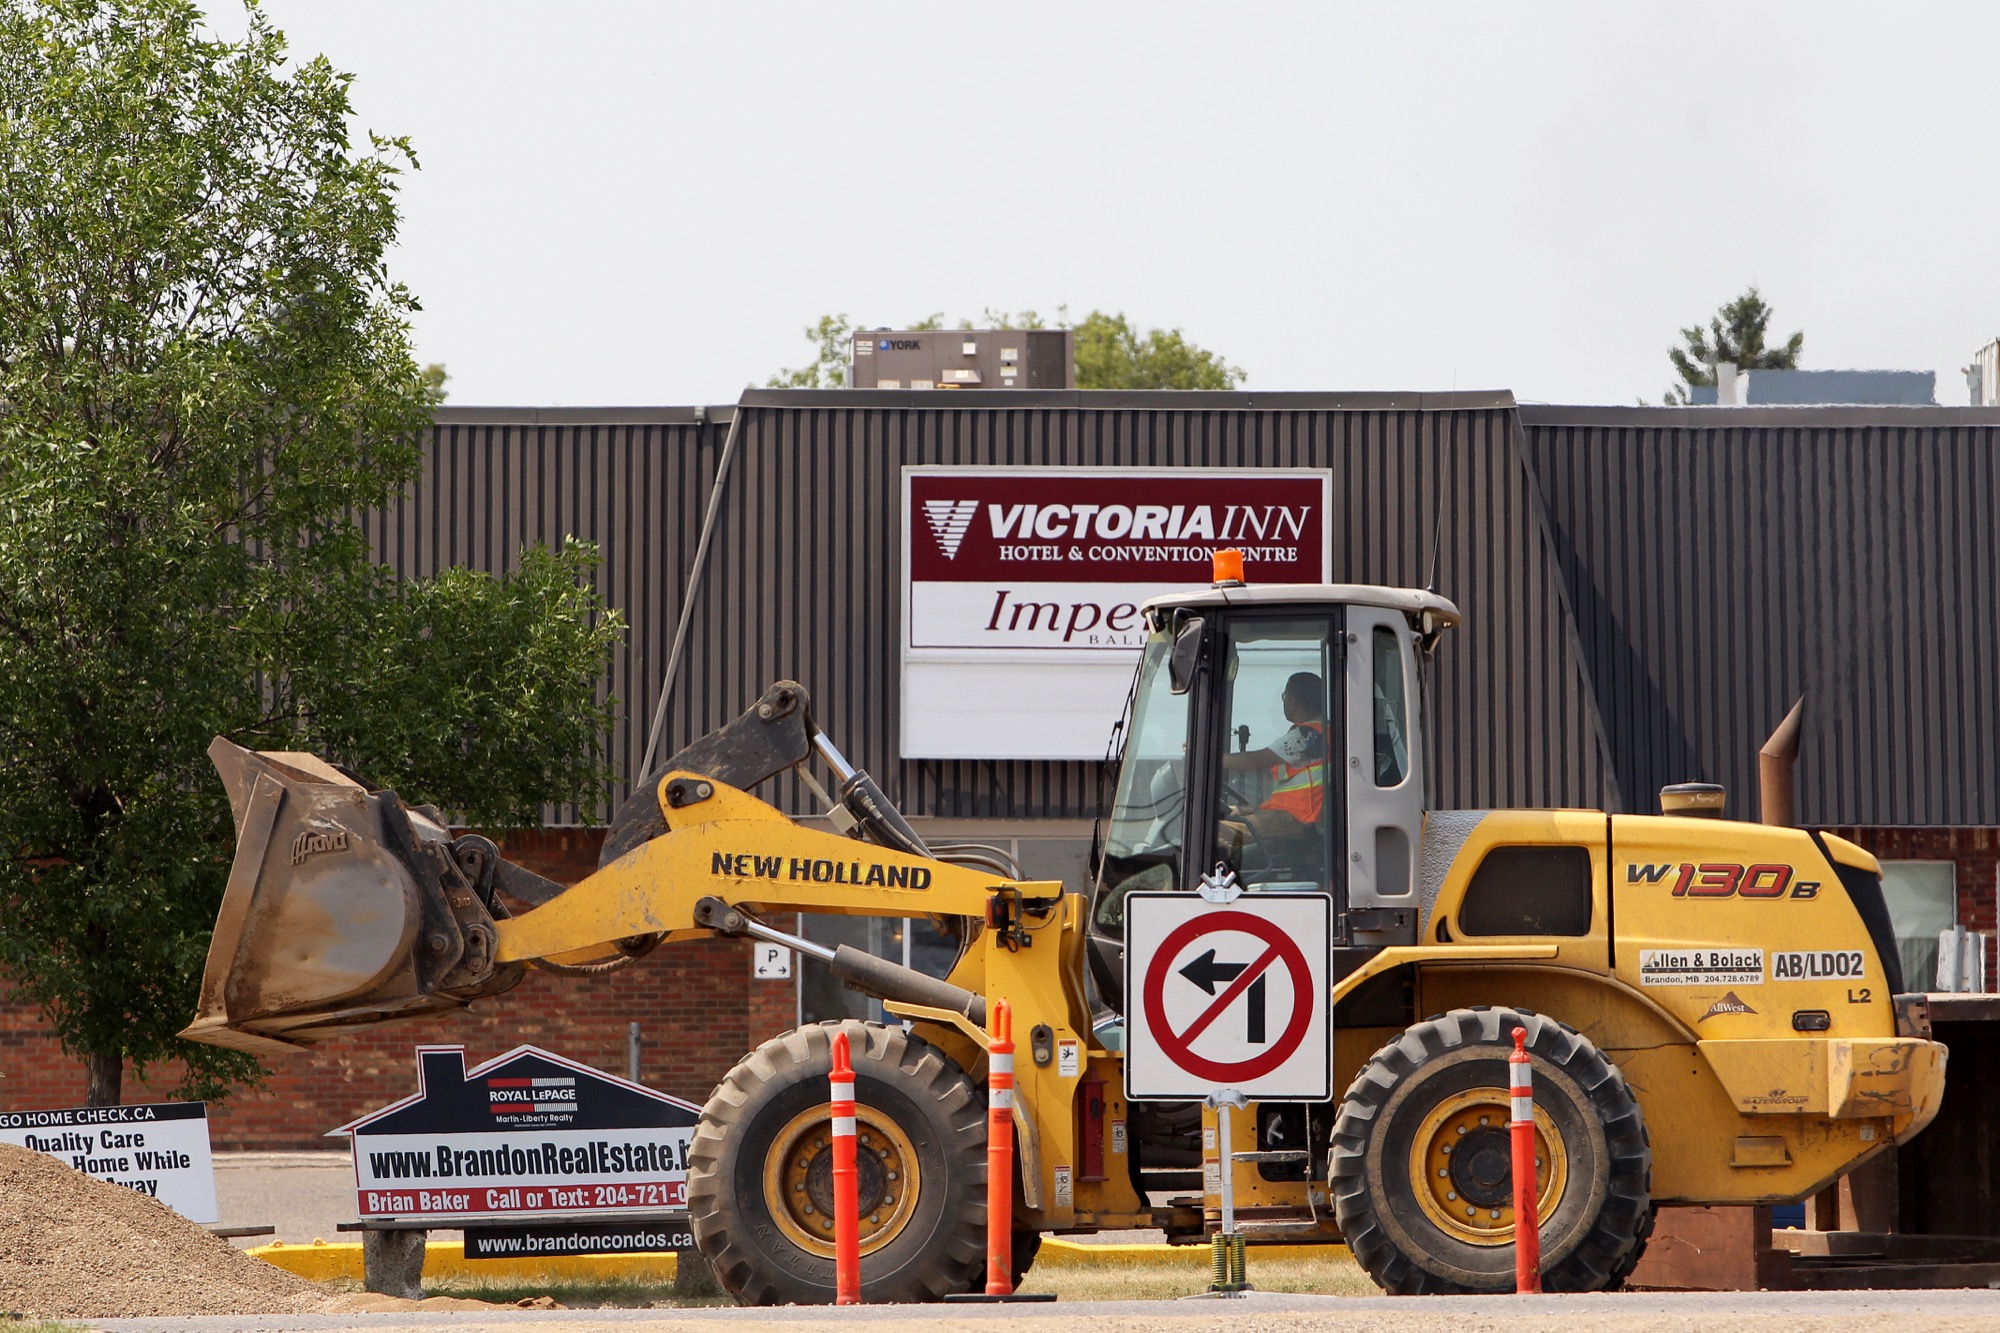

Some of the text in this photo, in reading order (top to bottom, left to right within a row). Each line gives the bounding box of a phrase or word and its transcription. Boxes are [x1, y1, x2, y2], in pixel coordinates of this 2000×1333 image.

[890, 340, 921, 351] YORK
[988, 504, 1311, 540] VICTORIA INN
[999, 546, 1298, 562] HOTEL & CONVENTION ENTRE
[985, 590, 1150, 642] Impe
[711, 851, 932, 890] NEW HOLLAND
[768, 949, 778, 962] P
[1693, 952, 1704, 967] &
[1710, 952, 1761, 967] Bolack
[1645, 975, 1683, 984] Brandon,
[1704, 975, 1760, 983] 204.728.6789
[1848, 988, 1872, 1003] L2
[1710, 1003, 1745, 1012] AllWest
[489, 1090, 531, 1102] ROYAL
[0, 1107, 156, 1127] GO HOME CHECK.CA
[496, 1113, 574, 1123] Martin-Liberty Realty
[25, 1130, 145, 1154] Quality Care
[72, 1150, 190, 1173] Home While
[368, 1192, 414, 1212] Brian
[421, 1190, 470, 1211] Baker
[486, 1188, 520, 1210] Call
[527, 1190, 544, 1207] or
[548, 1187, 589, 1206] Text:
[478, 1230, 693, 1253] www.brandoncondos.ca
